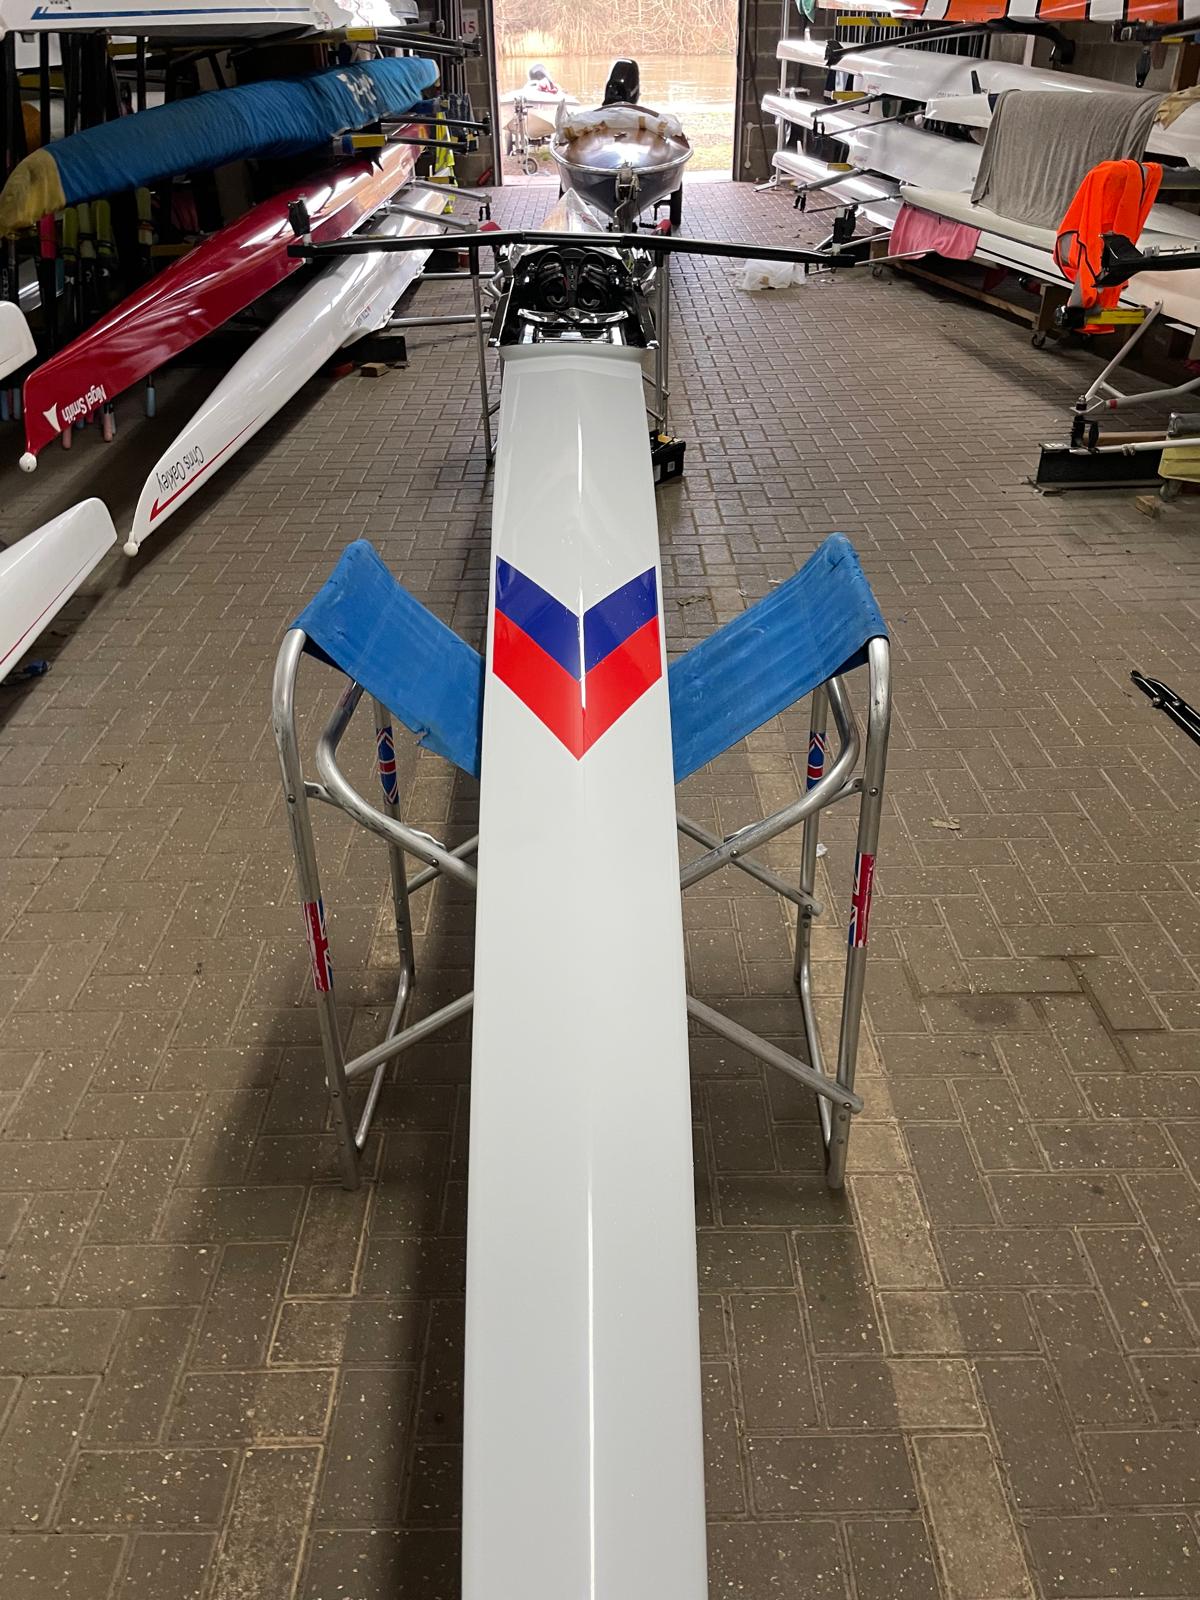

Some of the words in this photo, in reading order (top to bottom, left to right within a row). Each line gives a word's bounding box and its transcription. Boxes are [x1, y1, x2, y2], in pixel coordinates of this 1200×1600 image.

[61, 397, 87, 424] Smith
[85, 384, 107, 411] Nigel
[183, 446, 204, 471] Chris
[156, 461, 186, 493] Oakley
